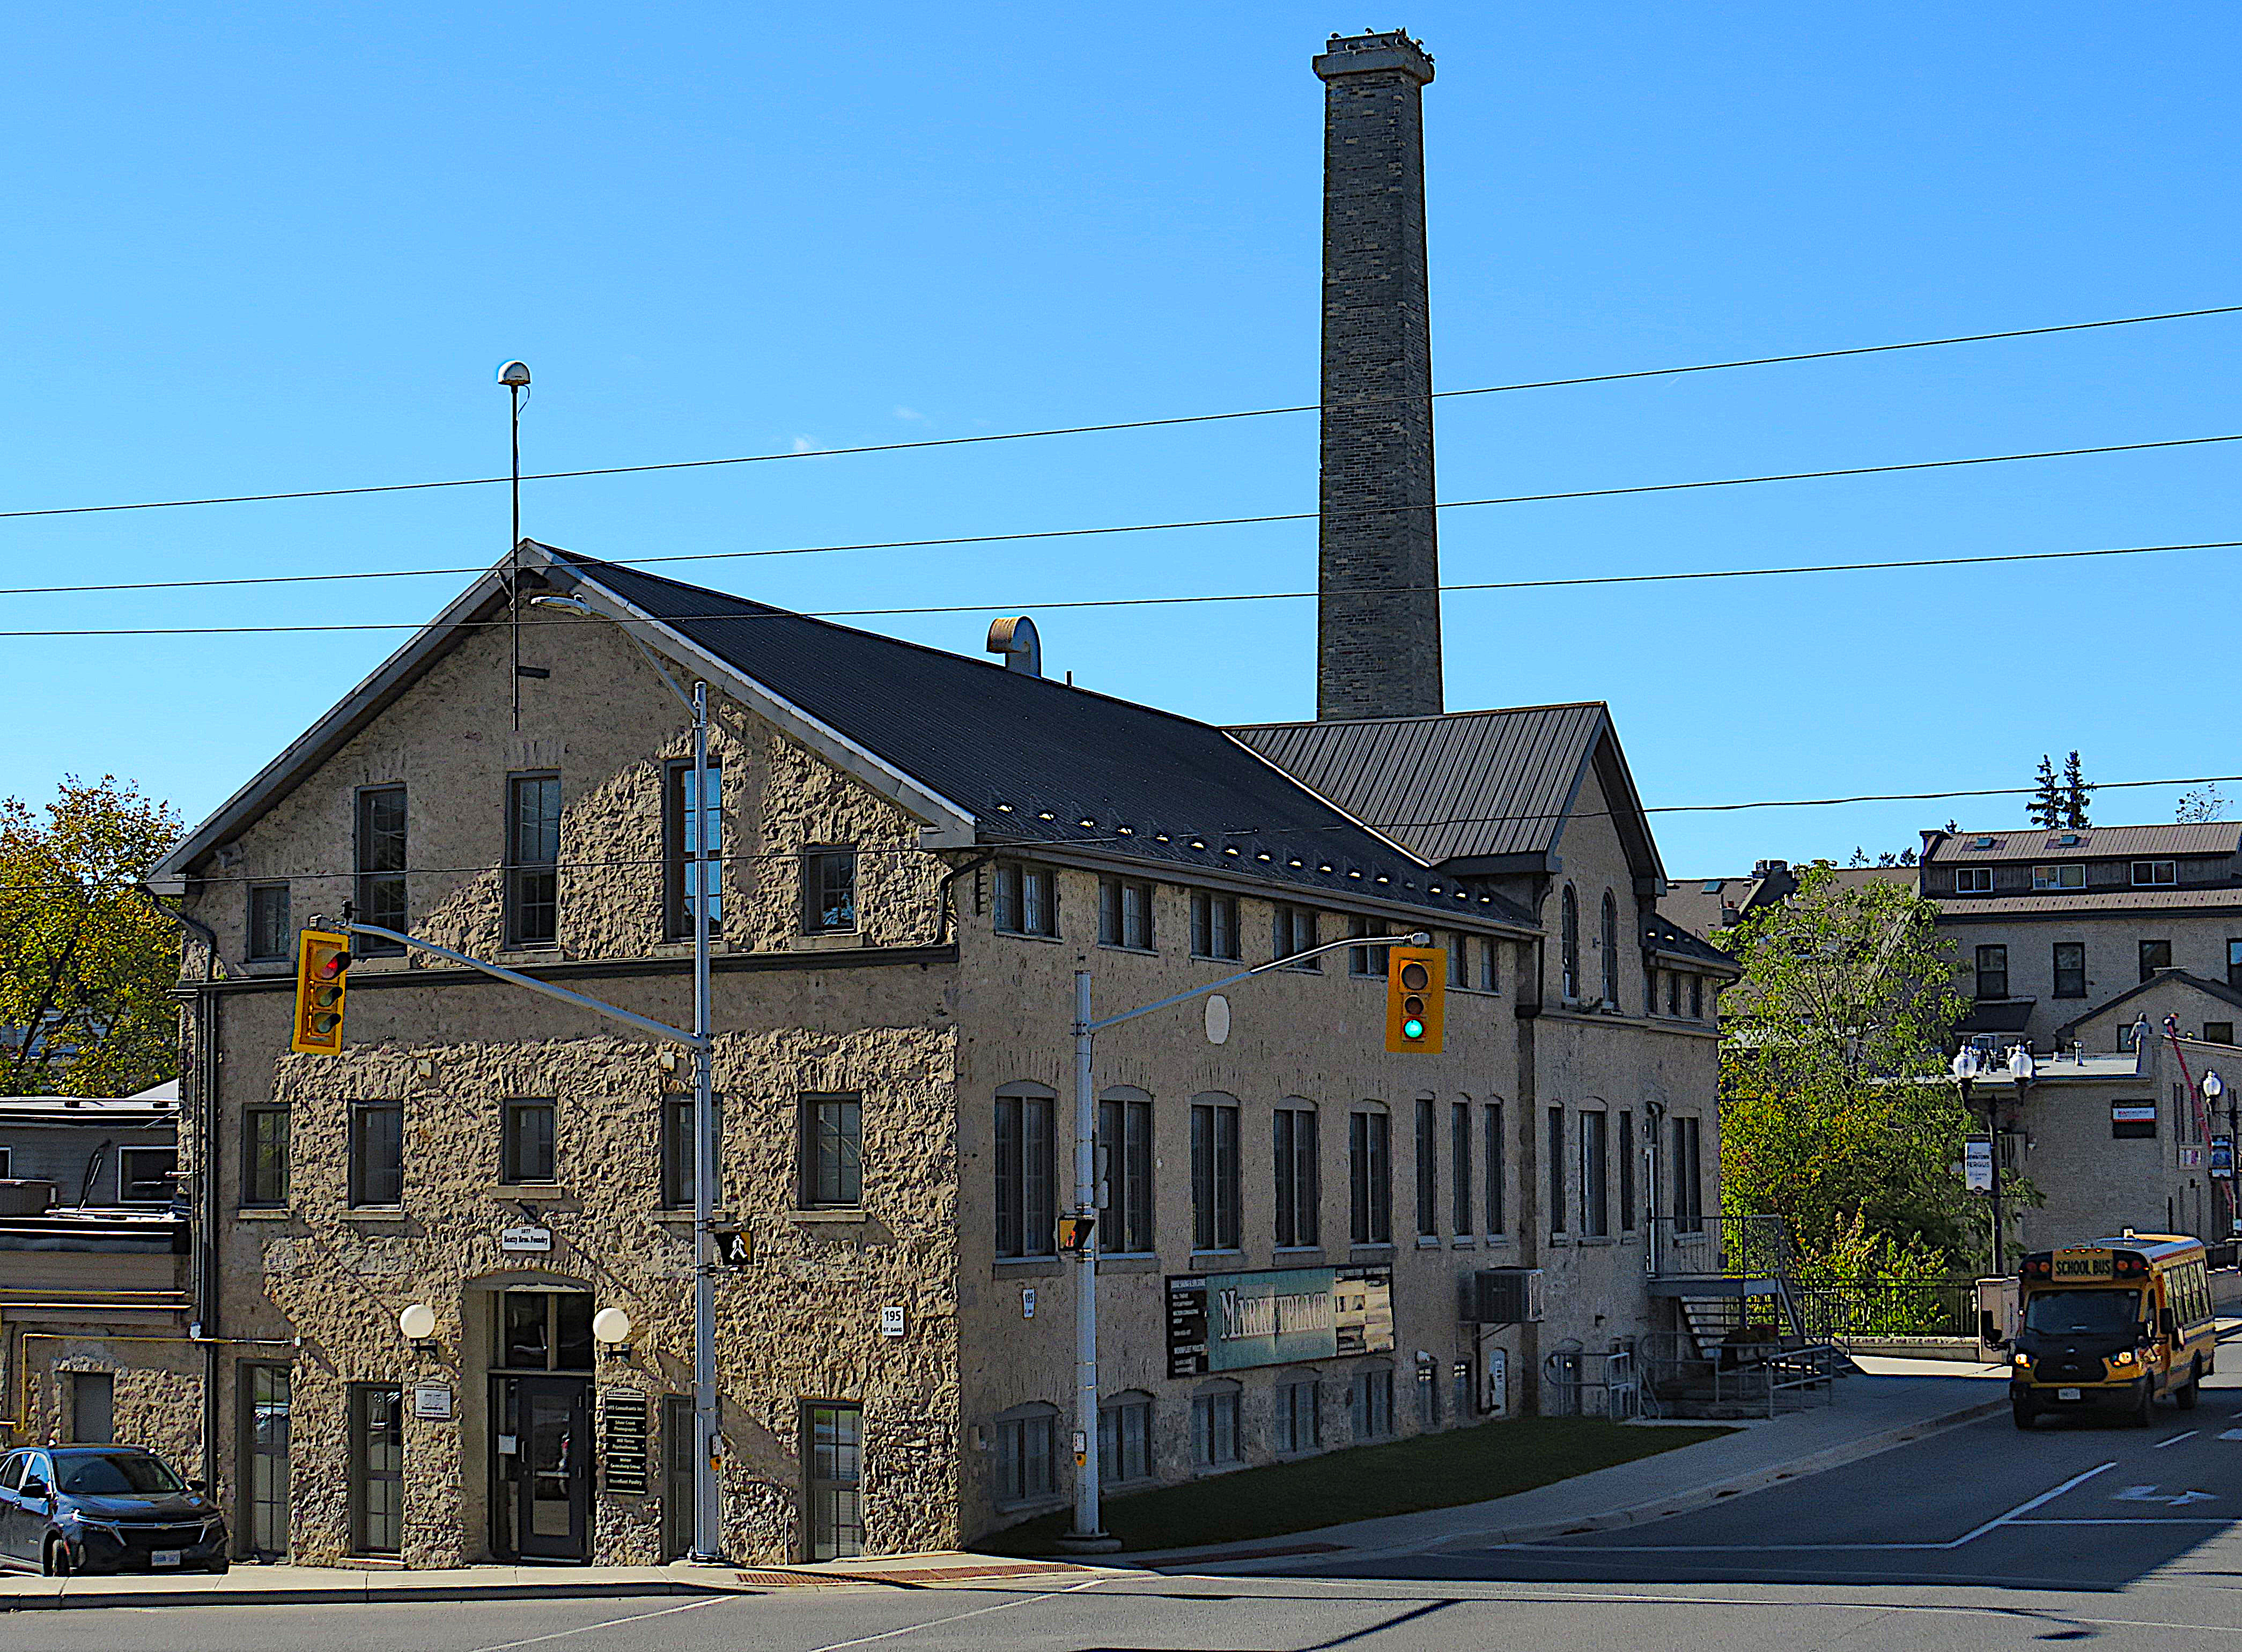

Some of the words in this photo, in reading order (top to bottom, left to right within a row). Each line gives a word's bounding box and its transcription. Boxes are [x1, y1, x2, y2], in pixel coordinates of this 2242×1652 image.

[2056, 1259, 2091, 1275] SCHOOL
[2093, 1259, 2111, 1275] BUS
[1024, 1292, 1034, 1304] 195
[884, 1310, 901, 1322] 195
